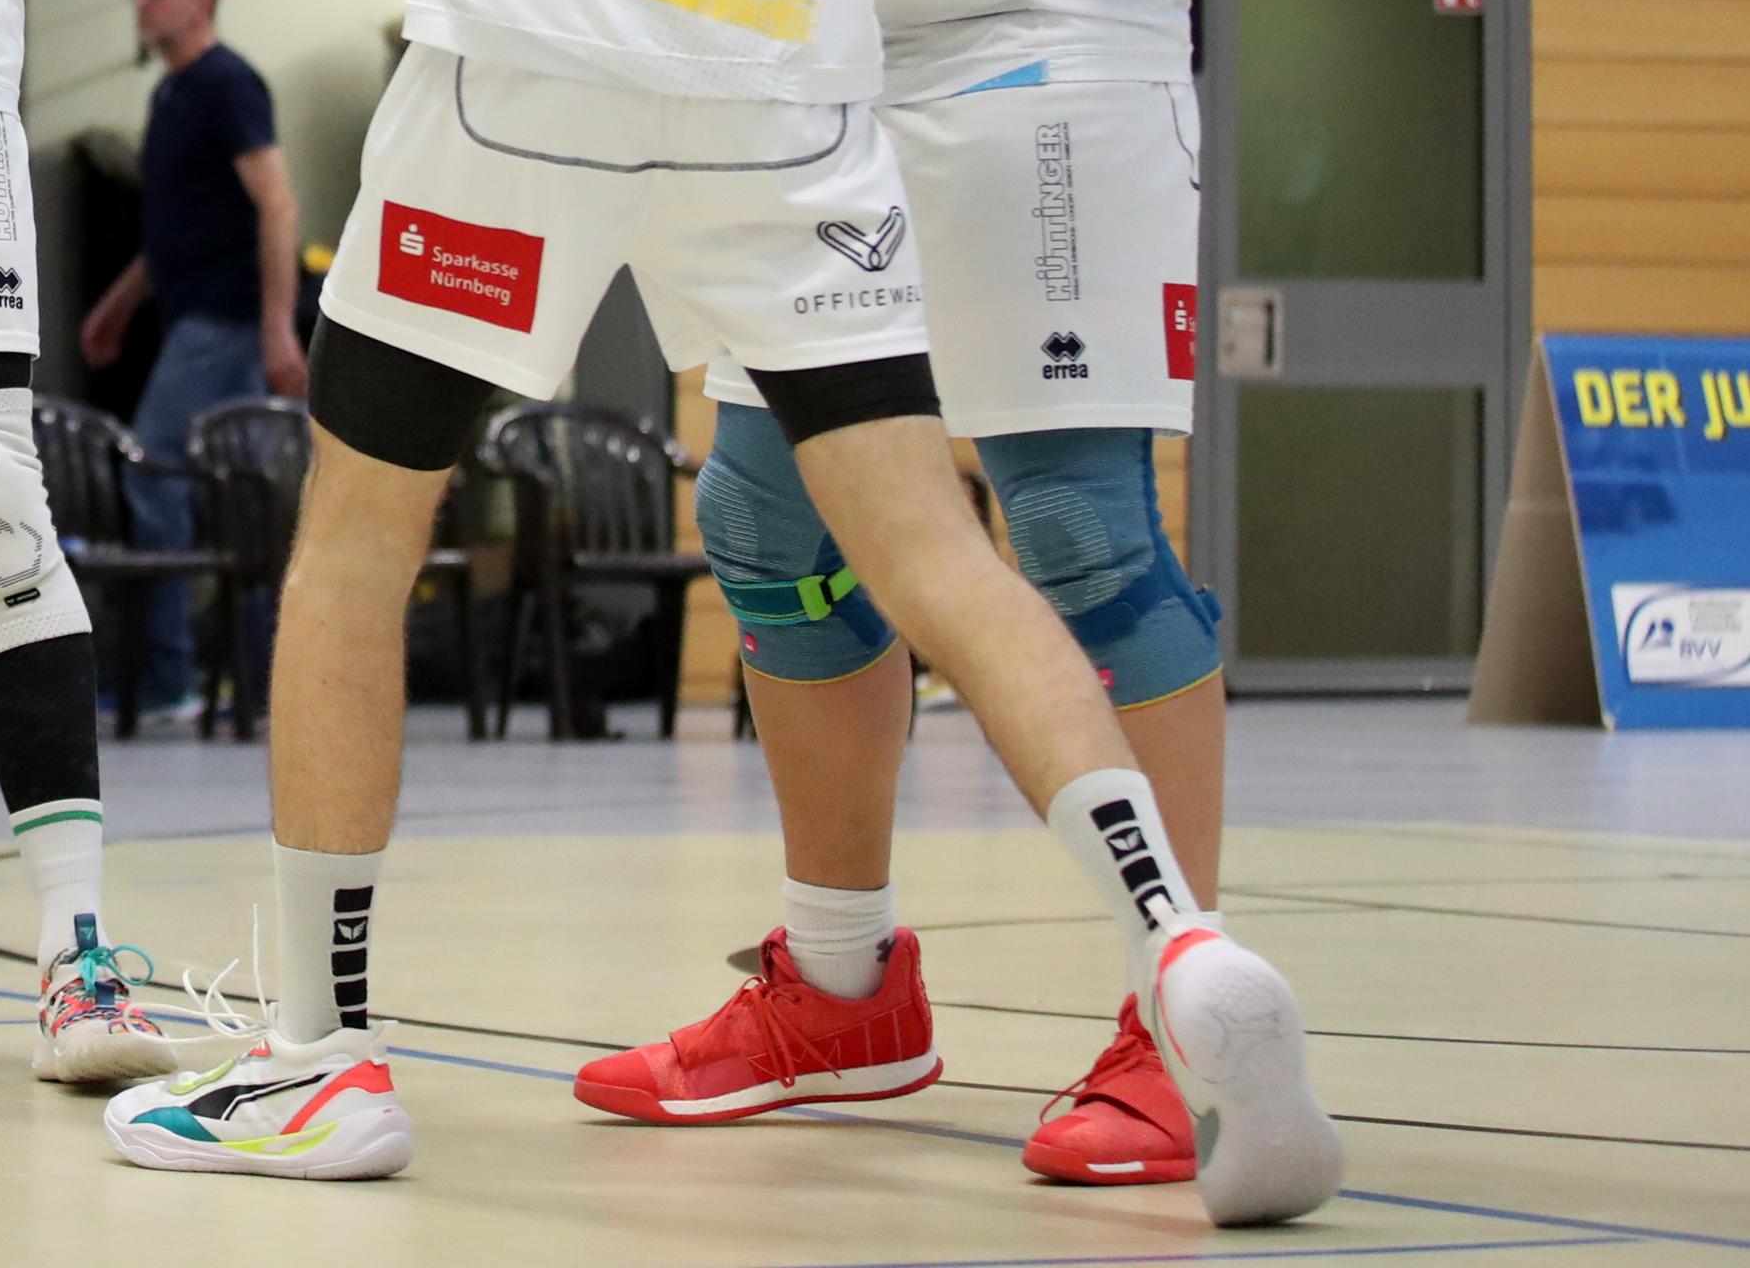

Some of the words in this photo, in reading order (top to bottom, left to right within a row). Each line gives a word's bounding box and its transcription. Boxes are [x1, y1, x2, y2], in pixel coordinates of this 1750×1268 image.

[432, 246, 519, 280] Sparkasse
[430, 269, 512, 306] Nürnberg
[1043, 363, 1088, 380] errea
[1573, 369, 1686, 429] DER
